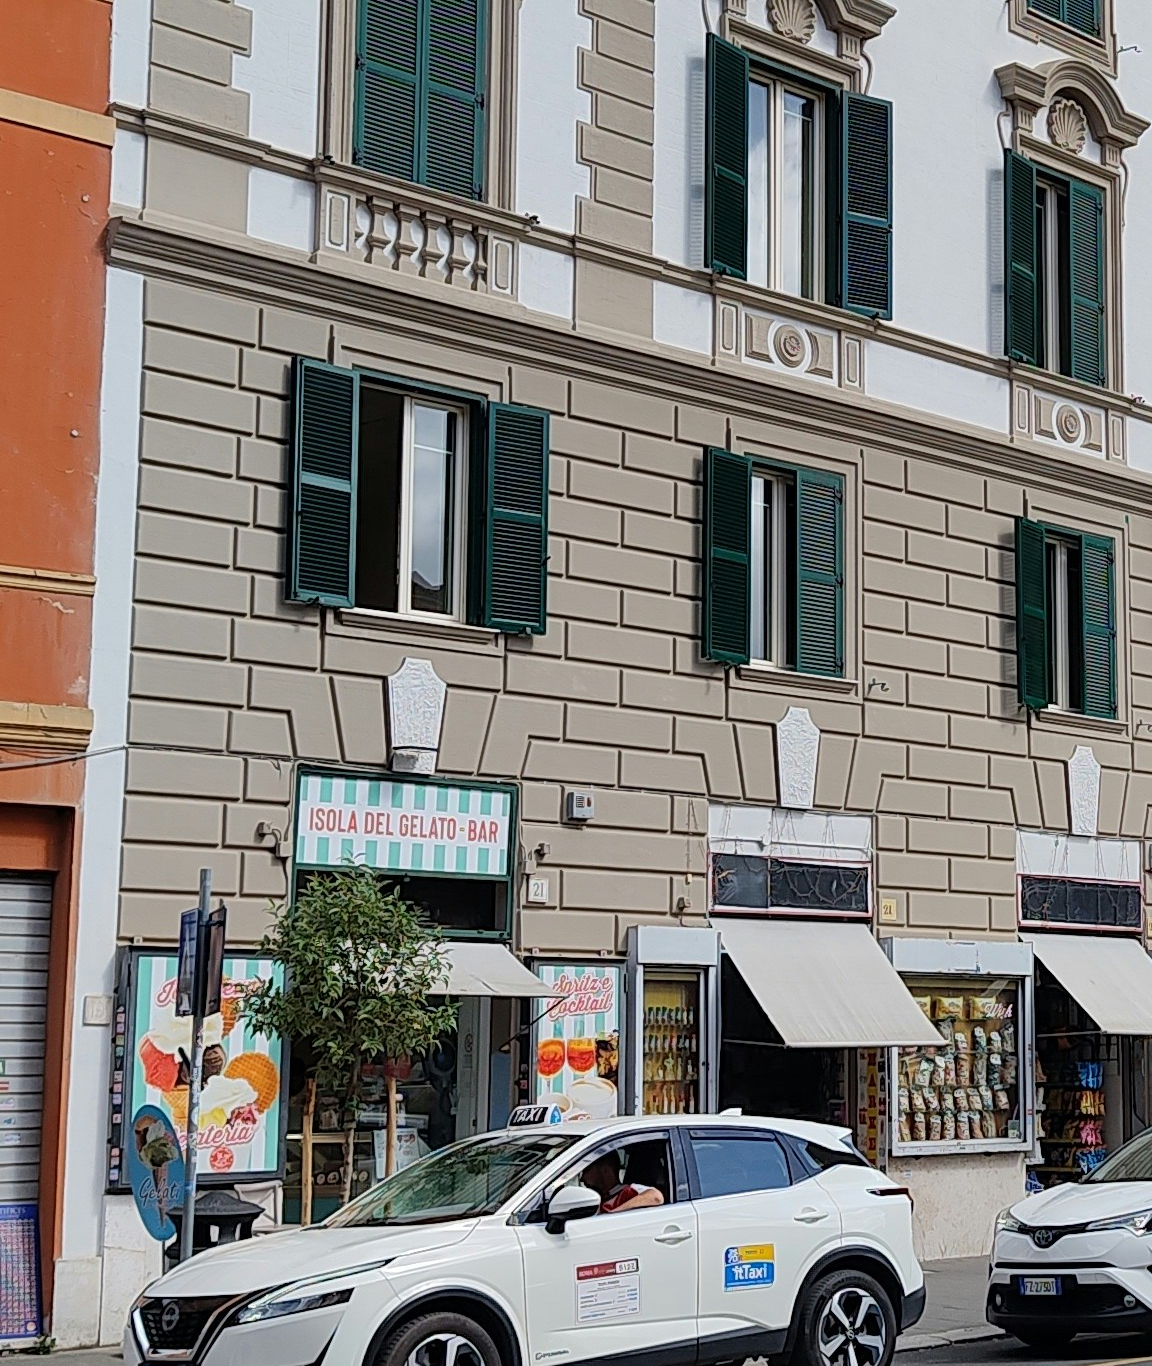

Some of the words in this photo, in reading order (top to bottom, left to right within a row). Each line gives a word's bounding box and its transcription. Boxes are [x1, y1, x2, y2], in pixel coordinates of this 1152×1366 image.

[309, 807, 358, 834] ISOLA
[363, 811, 394, 836] DEL
[532, 882, 544, 898] 21
[882, 904, 892, 915] 21
[549, 993, 612, 1018] Cocktail
[512, 1106, 543, 1124] TAXI
[138, 1176, 181, 1206] Gelati
[732, 1263, 767, 1281] itTaxi
